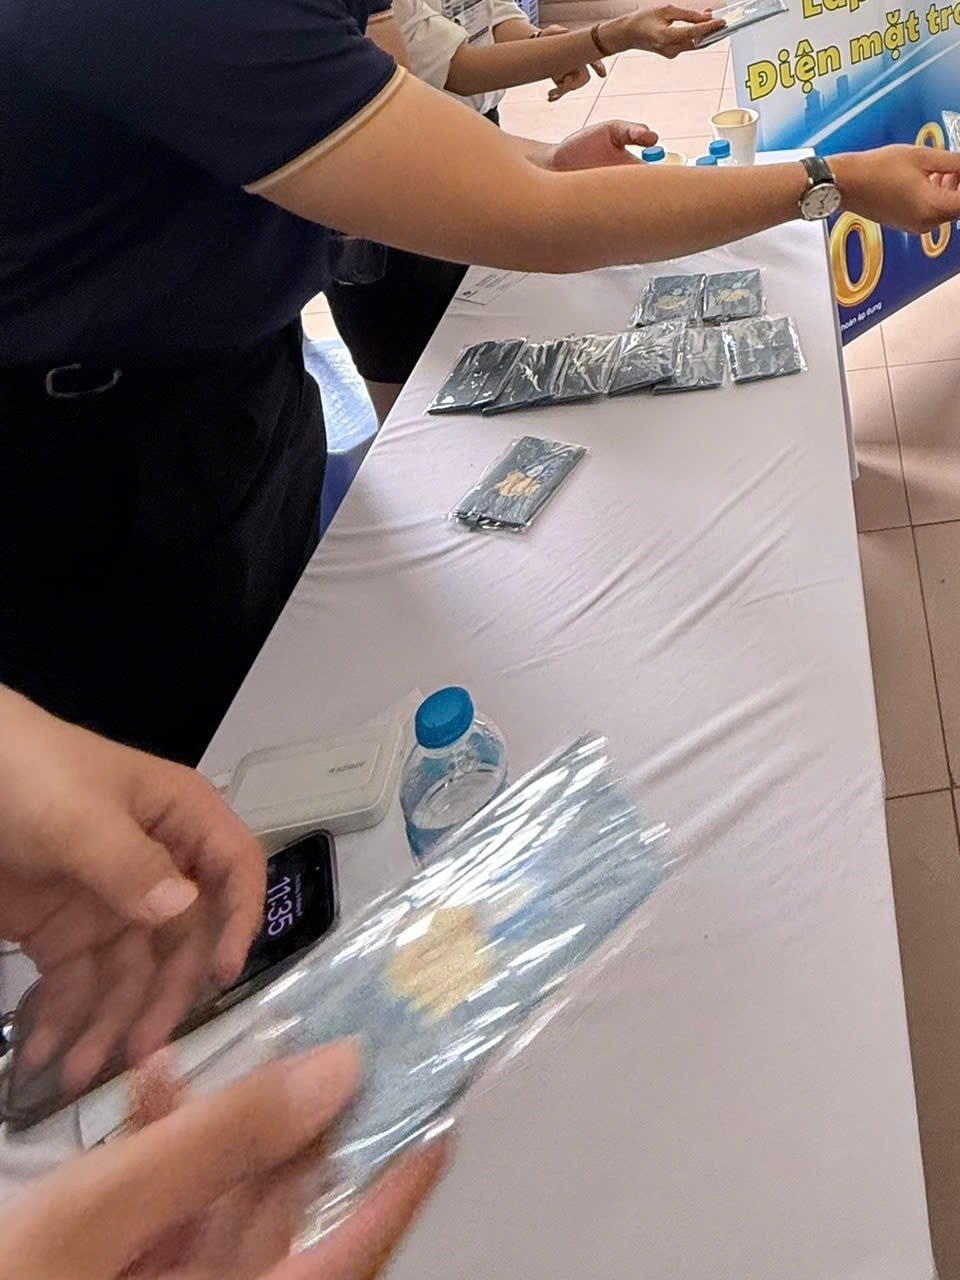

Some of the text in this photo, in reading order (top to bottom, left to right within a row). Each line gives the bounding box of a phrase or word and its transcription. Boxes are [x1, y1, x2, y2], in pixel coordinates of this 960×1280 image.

[745, 38, 842, 102] Điện
[849, 9, 921, 61] mặt
[267, 876, 293, 936] 11:35
